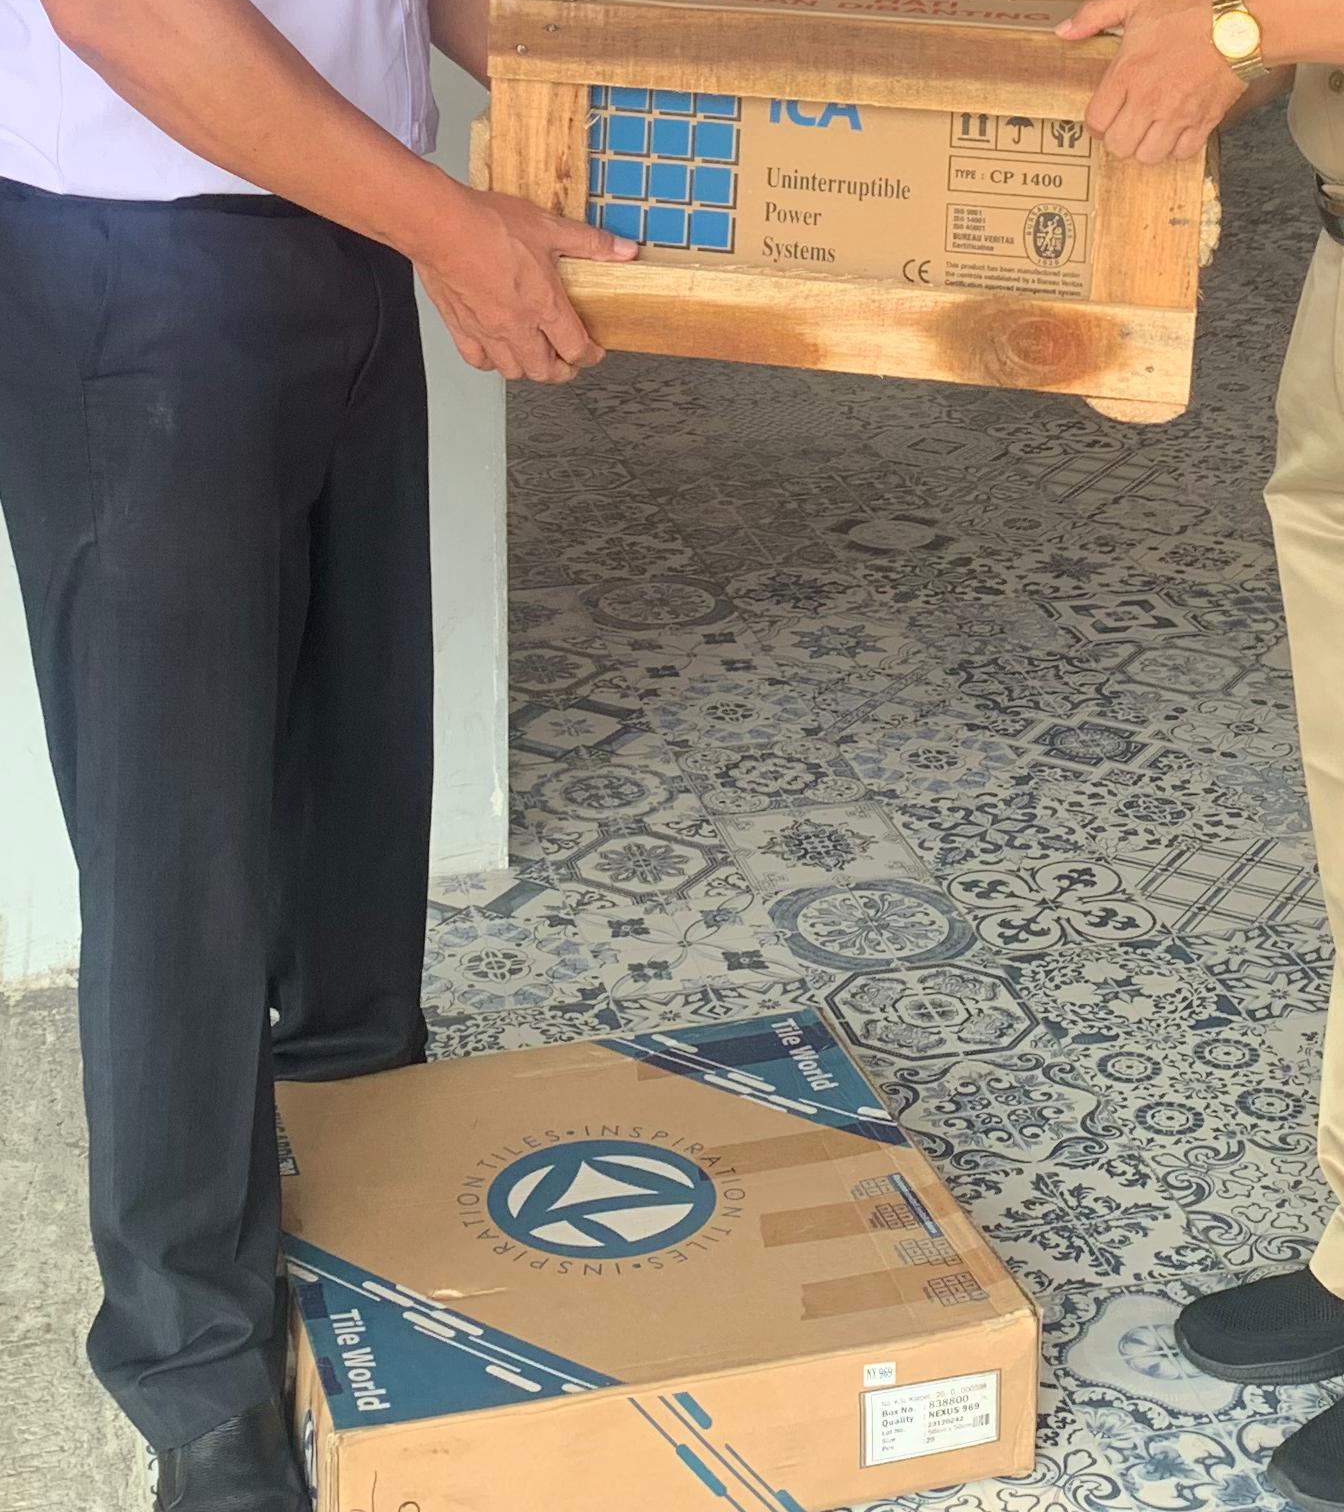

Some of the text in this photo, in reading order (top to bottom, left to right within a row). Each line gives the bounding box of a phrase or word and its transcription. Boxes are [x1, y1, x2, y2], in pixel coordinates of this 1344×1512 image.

[837, 1, 1051, 21] DIBANTING
[766, 166, 911, 202] Uninterruptible
[955, 168, 976, 180] TYPE
[990, 169, 1015, 184] CP
[1021, 172, 1063, 188] 1400
[764, 201, 822, 226] Power
[762, 236, 836, 263] Systems
[953, 233, 1015, 245] BUREAU VERITAS
[771, 1017, 839, 1092] Tile World
[456, 1129, 621, 1276] INSPIRATION TILES
[584, 1124, 746, 1270] INSPIRATION TILES
[329, 1308, 391, 1412] Tile World
[882, 1407, 898, 1418] Box
[928, 1394, 970, 1409] 838800
[882, 1402, 980, 1428] Quality NEXUS 969
